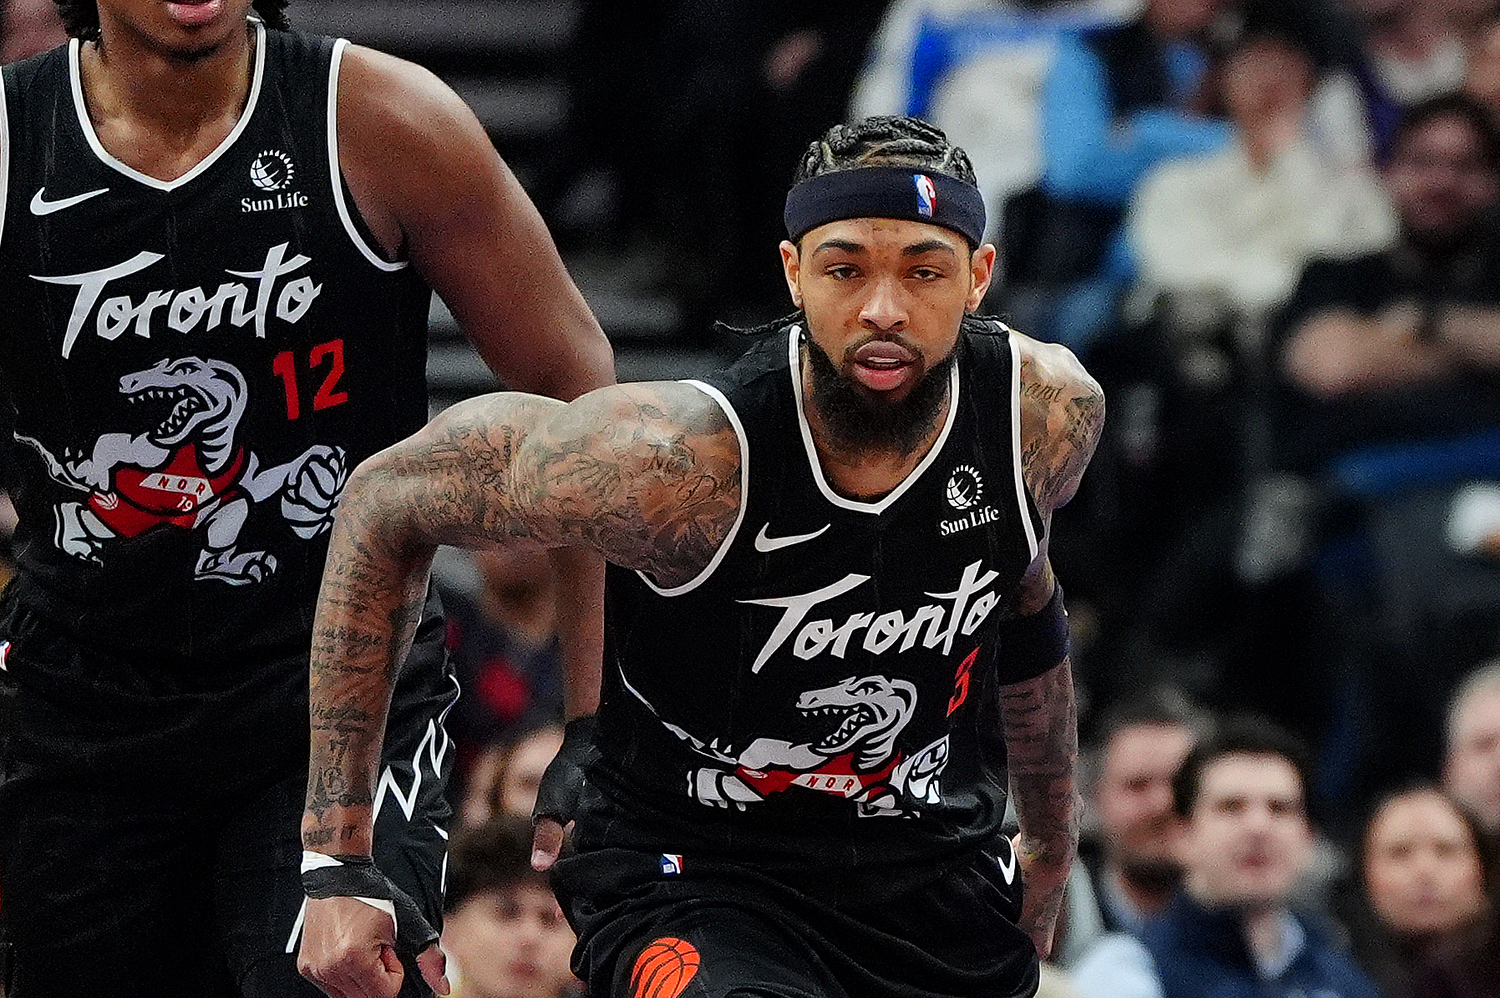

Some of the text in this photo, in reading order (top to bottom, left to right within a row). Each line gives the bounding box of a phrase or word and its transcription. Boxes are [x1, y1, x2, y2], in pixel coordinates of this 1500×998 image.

[241, 191, 308, 213] Sun Life
[28, 241, 323, 359] Toronto
[272, 338, 348, 420] 12
[940, 505, 1000, 536] Sun Life
[735, 559, 1001, 674] Toronto
